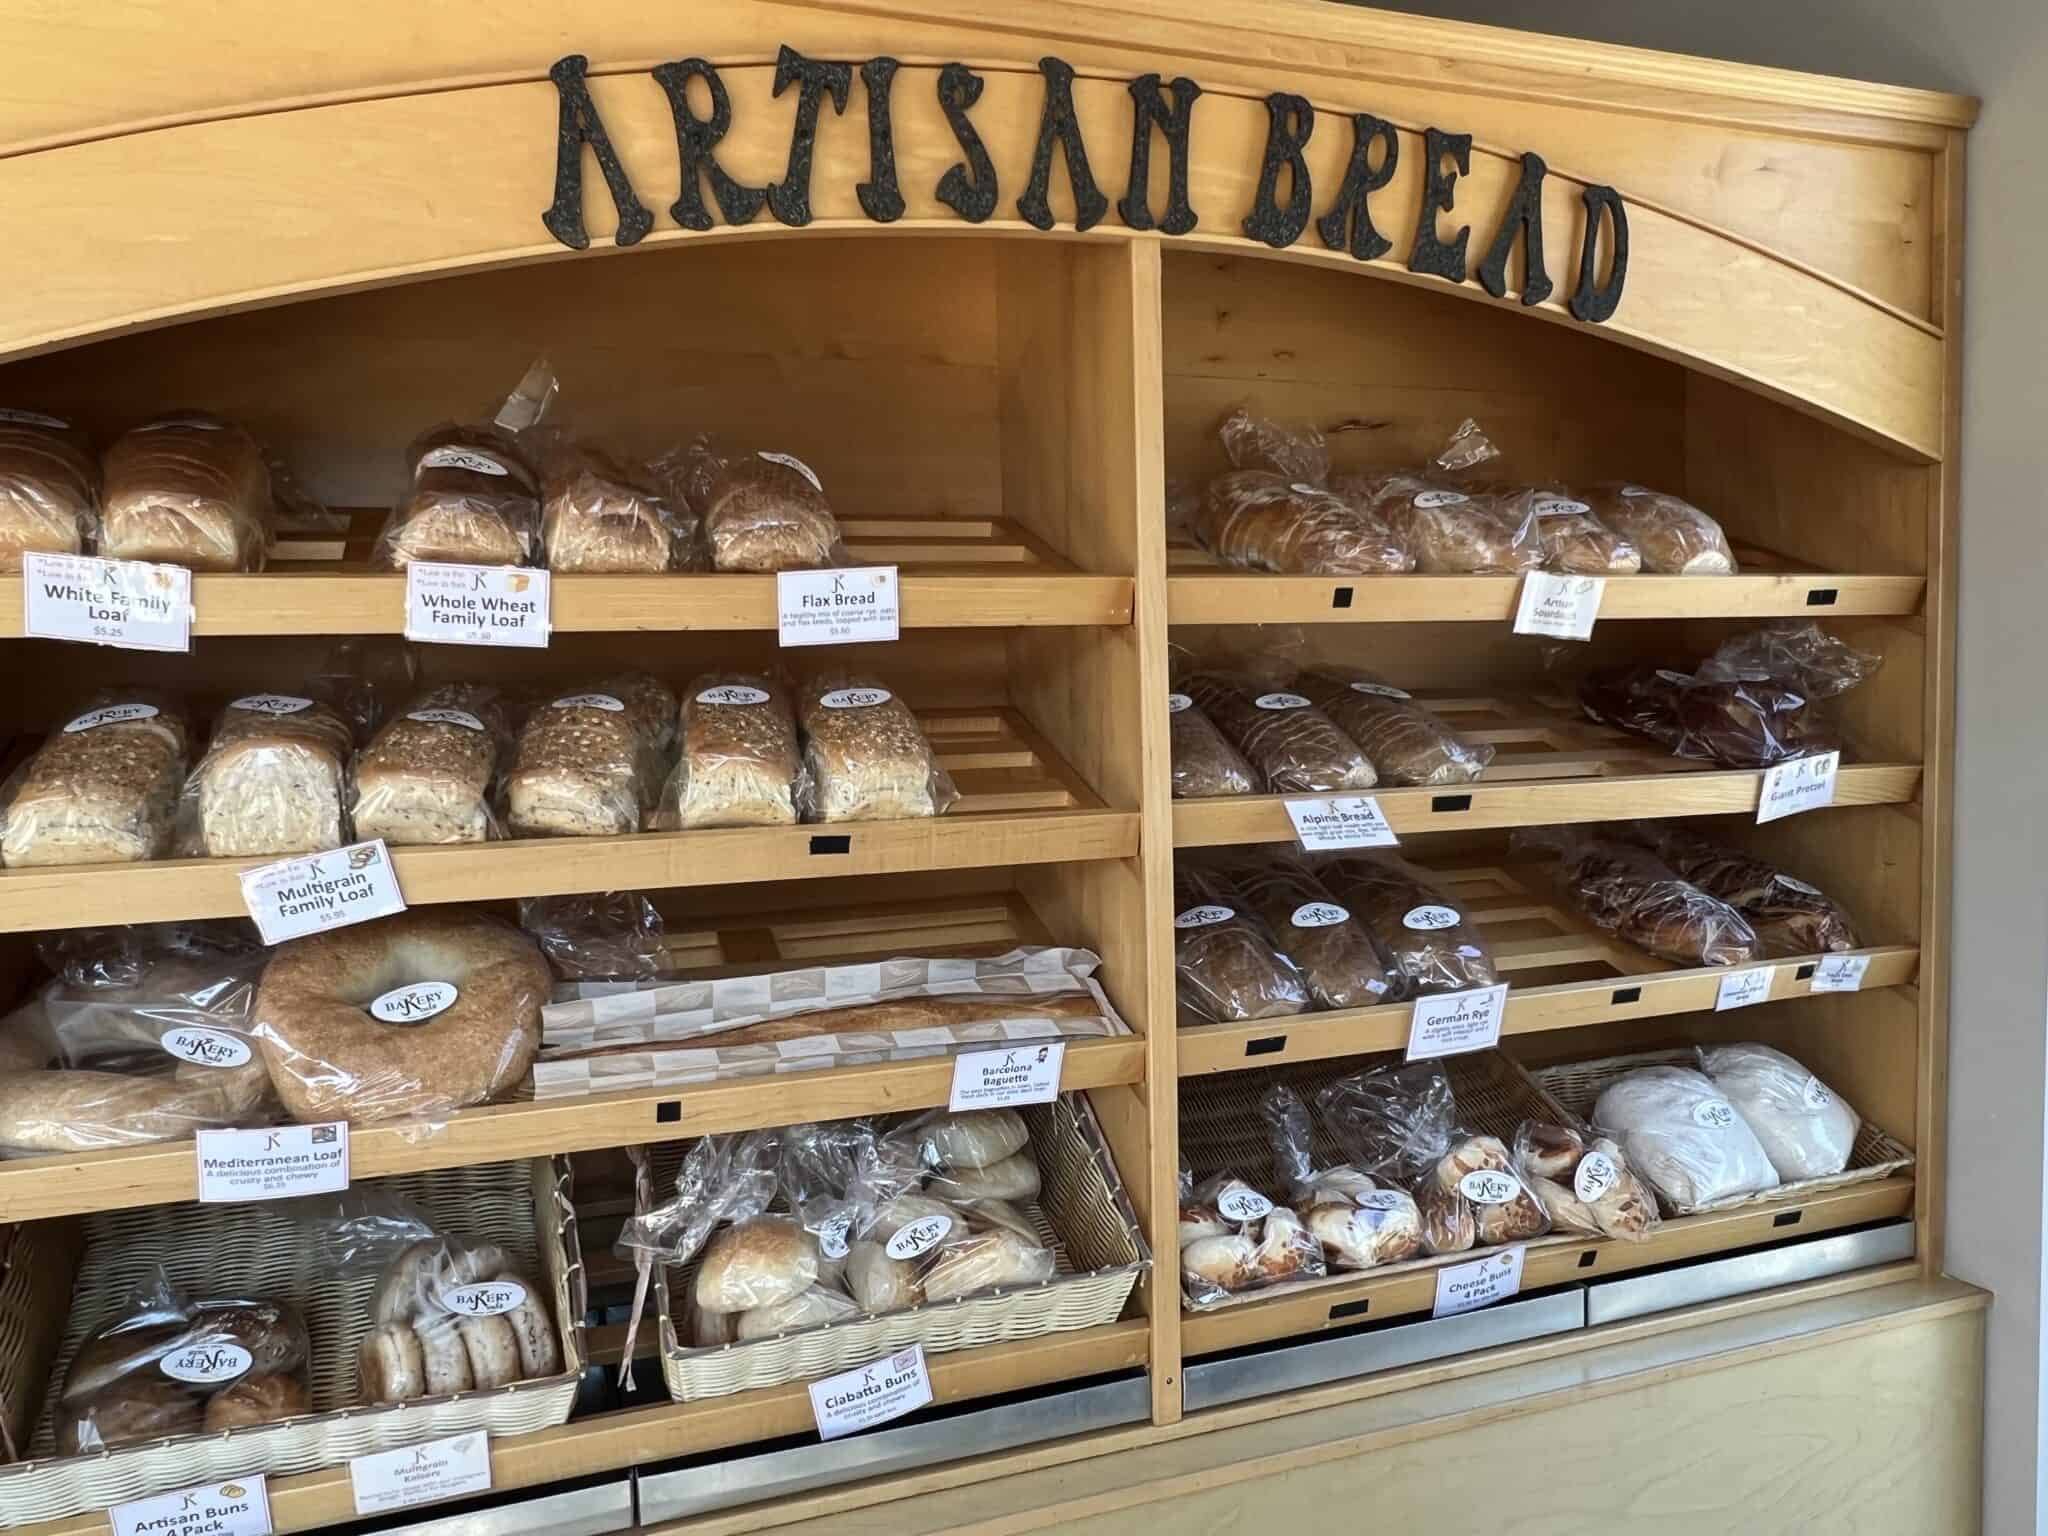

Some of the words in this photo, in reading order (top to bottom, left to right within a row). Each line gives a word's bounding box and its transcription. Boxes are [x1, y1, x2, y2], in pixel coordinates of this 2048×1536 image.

[542, 44, 1202, 249] ARTISAN
[1242, 92, 1629, 322] BREAD
[44, 583, 104, 605] White
[421, 593, 476, 609] Whole
[481, 597, 536, 613] Wheat
[802, 594, 831, 608] Flax
[835, 591, 875, 606] Bread
[88, 605, 130, 623] Loaf
[432, 610, 486, 628] Family
[491, 614, 526, 628] Loaf
[1534, 607, 1577, 618] Sourd
[1302, 813, 1340, 825] Alpine
[1340, 810, 1376, 822] Bread
[277, 872, 367, 904] Multigrain
[279, 896, 335, 918] Family
[339, 883, 375, 903] Loaf
[384, 991, 443, 1016] BAKERY
[1427, 1012, 1470, 1026] German
[1471, 1008, 1491, 1020] Rye
[175, 1035, 240, 1059] BAKERY
[982, 1063, 1033, 1077] Barcelona
[983, 1074, 1029, 1087] Baguette
[203, 1151, 310, 1169] Mediterranean
[313, 1148, 343, 1161] Loaf
[263, 1173, 284, 1182] and
[1469, 1177, 1511, 1200] BAKERY
[895, 1220, 941, 1251] BAKERY
[1448, 1277, 1487, 1293] Cheese
[1473, 1284, 1496, 1297] Pack
[455, 1289, 513, 1311] BAKERY
[175, 1349, 239, 1374] BAKERY
[825, 1384, 882, 1409] Ciabatta
[885, 1367, 918, 1389] Buns
[134, 1511, 200, 1533] Artisan
[205, 1502, 250, 1519] Buns
[182, 1520, 224, 1536] Pack
